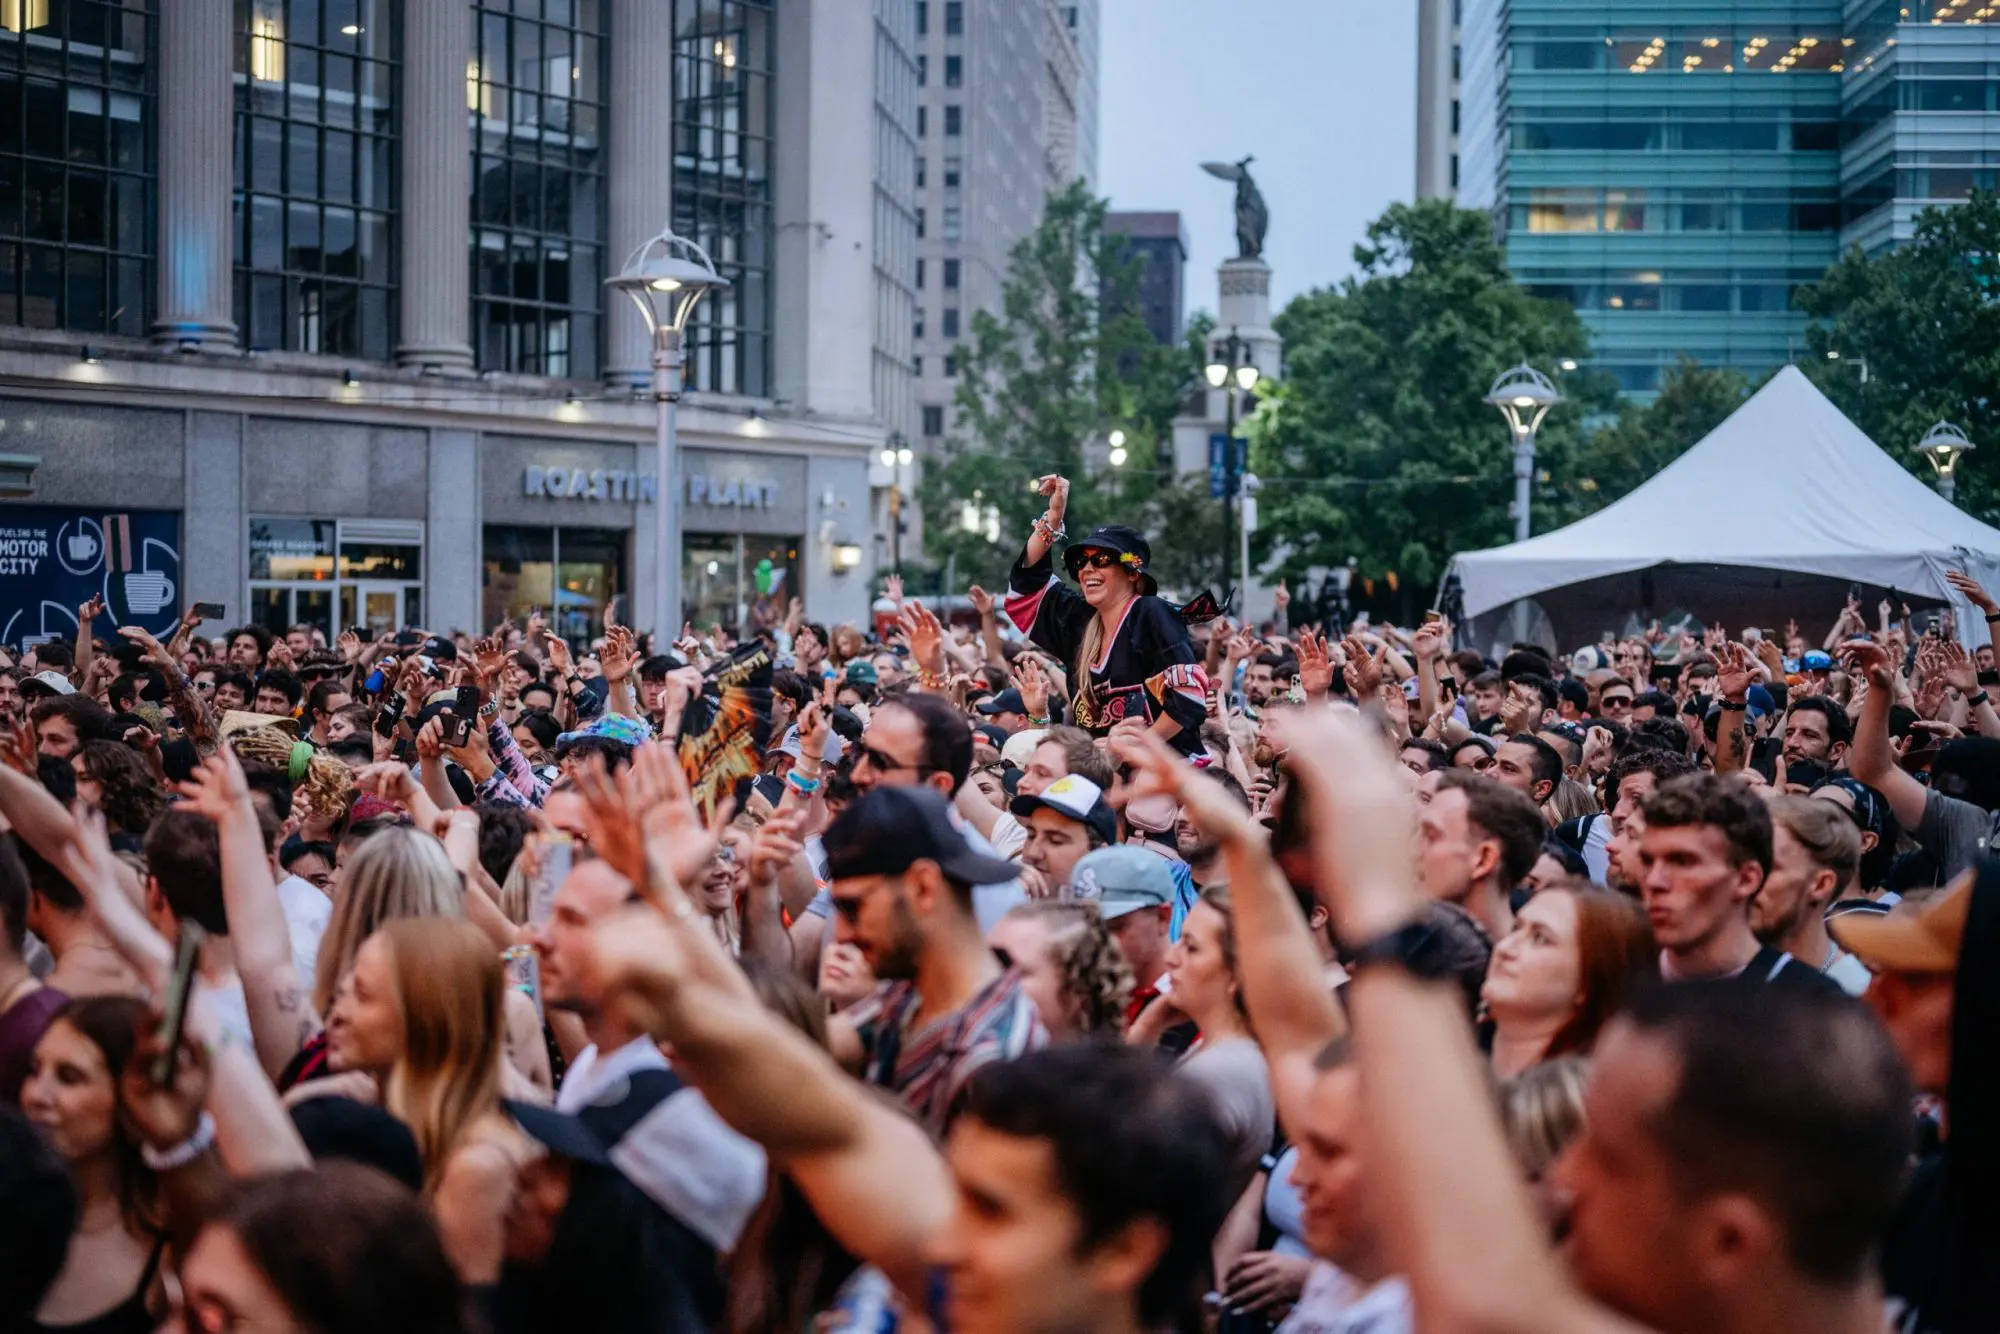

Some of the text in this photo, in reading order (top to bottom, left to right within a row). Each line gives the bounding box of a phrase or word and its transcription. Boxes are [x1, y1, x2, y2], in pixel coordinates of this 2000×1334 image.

[524, 464, 780, 508] ROASTIN PLANT
[33, 529, 47, 539] THE
[0, 539, 48, 557] MOTOR
[0, 557, 39, 575] CITY
